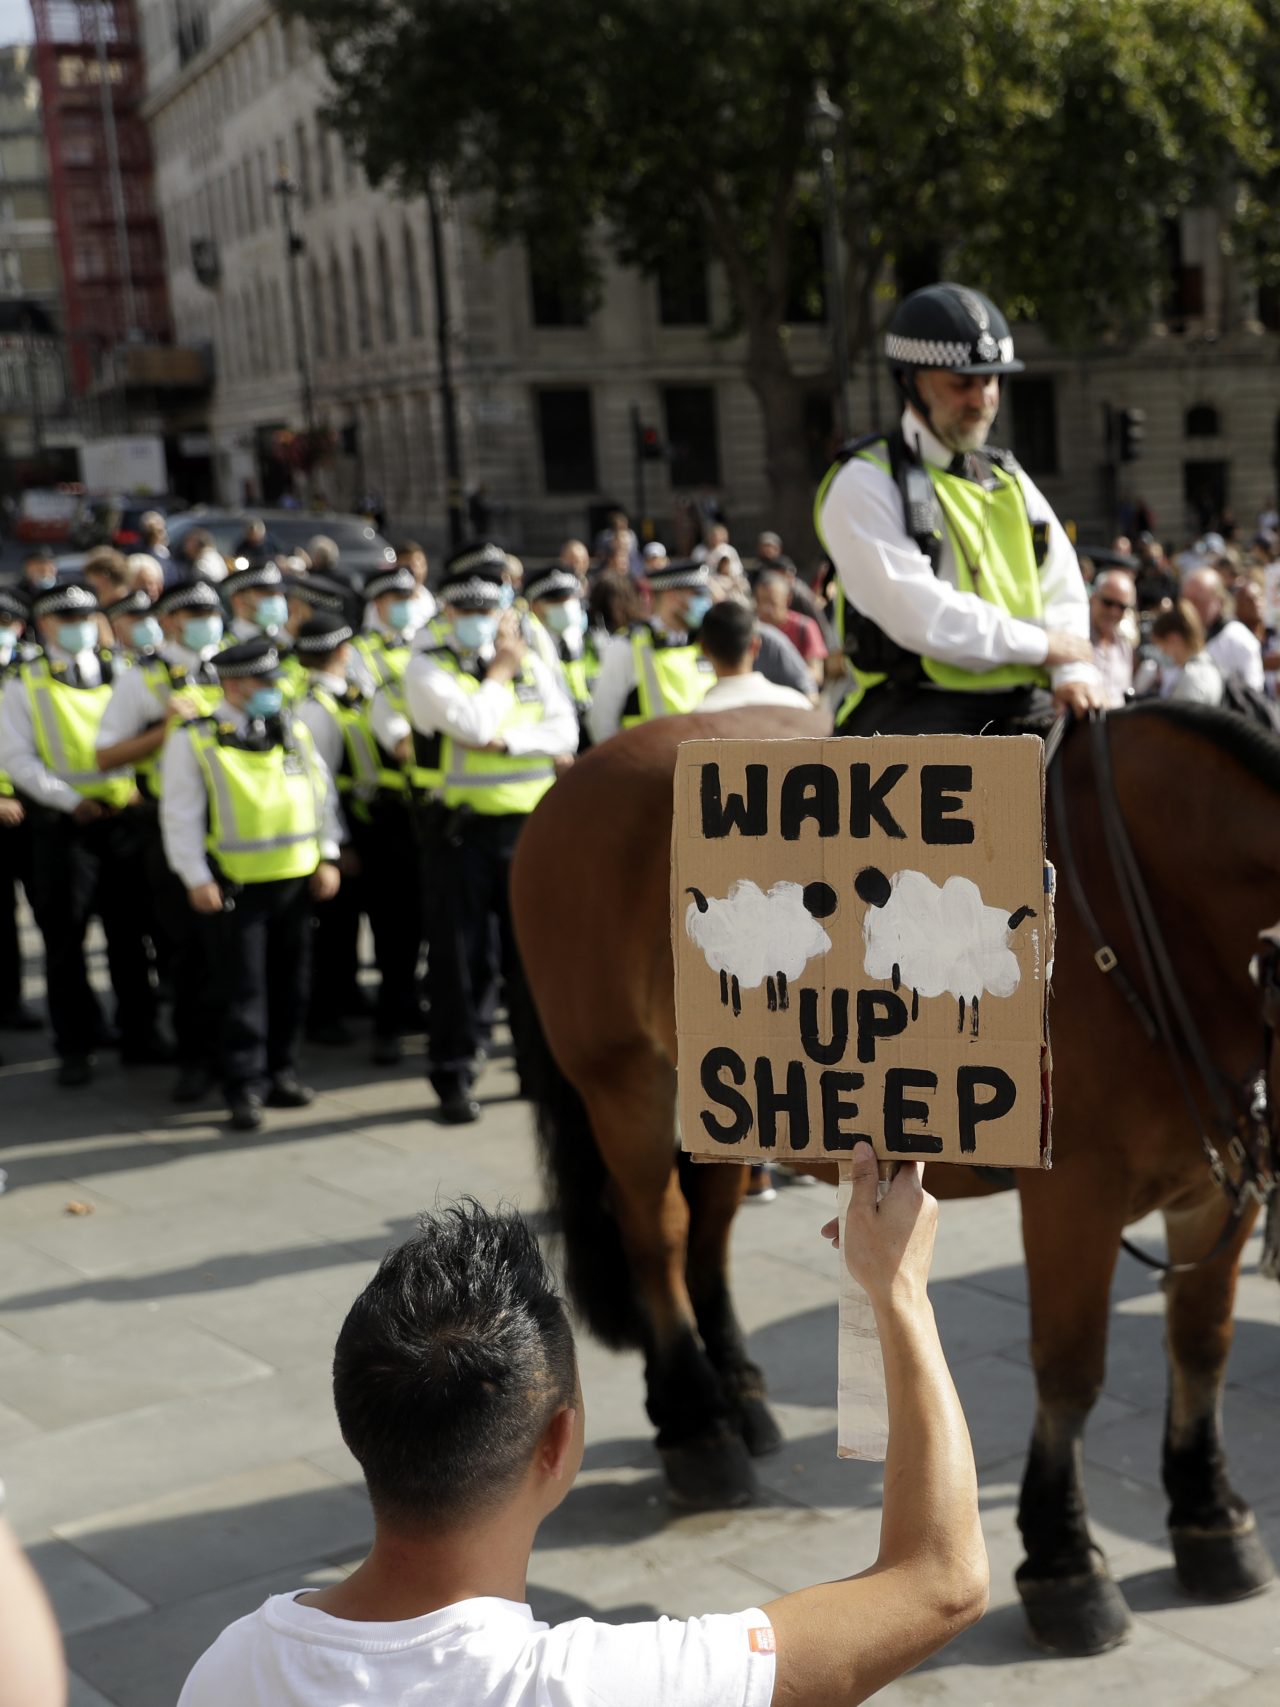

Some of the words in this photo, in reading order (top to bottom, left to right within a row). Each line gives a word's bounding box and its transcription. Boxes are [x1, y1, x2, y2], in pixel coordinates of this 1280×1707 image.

[700, 762, 975, 845] WAKE
[800, 987, 908, 1065] UP
[700, 1046, 1017, 1154] SHEEP
